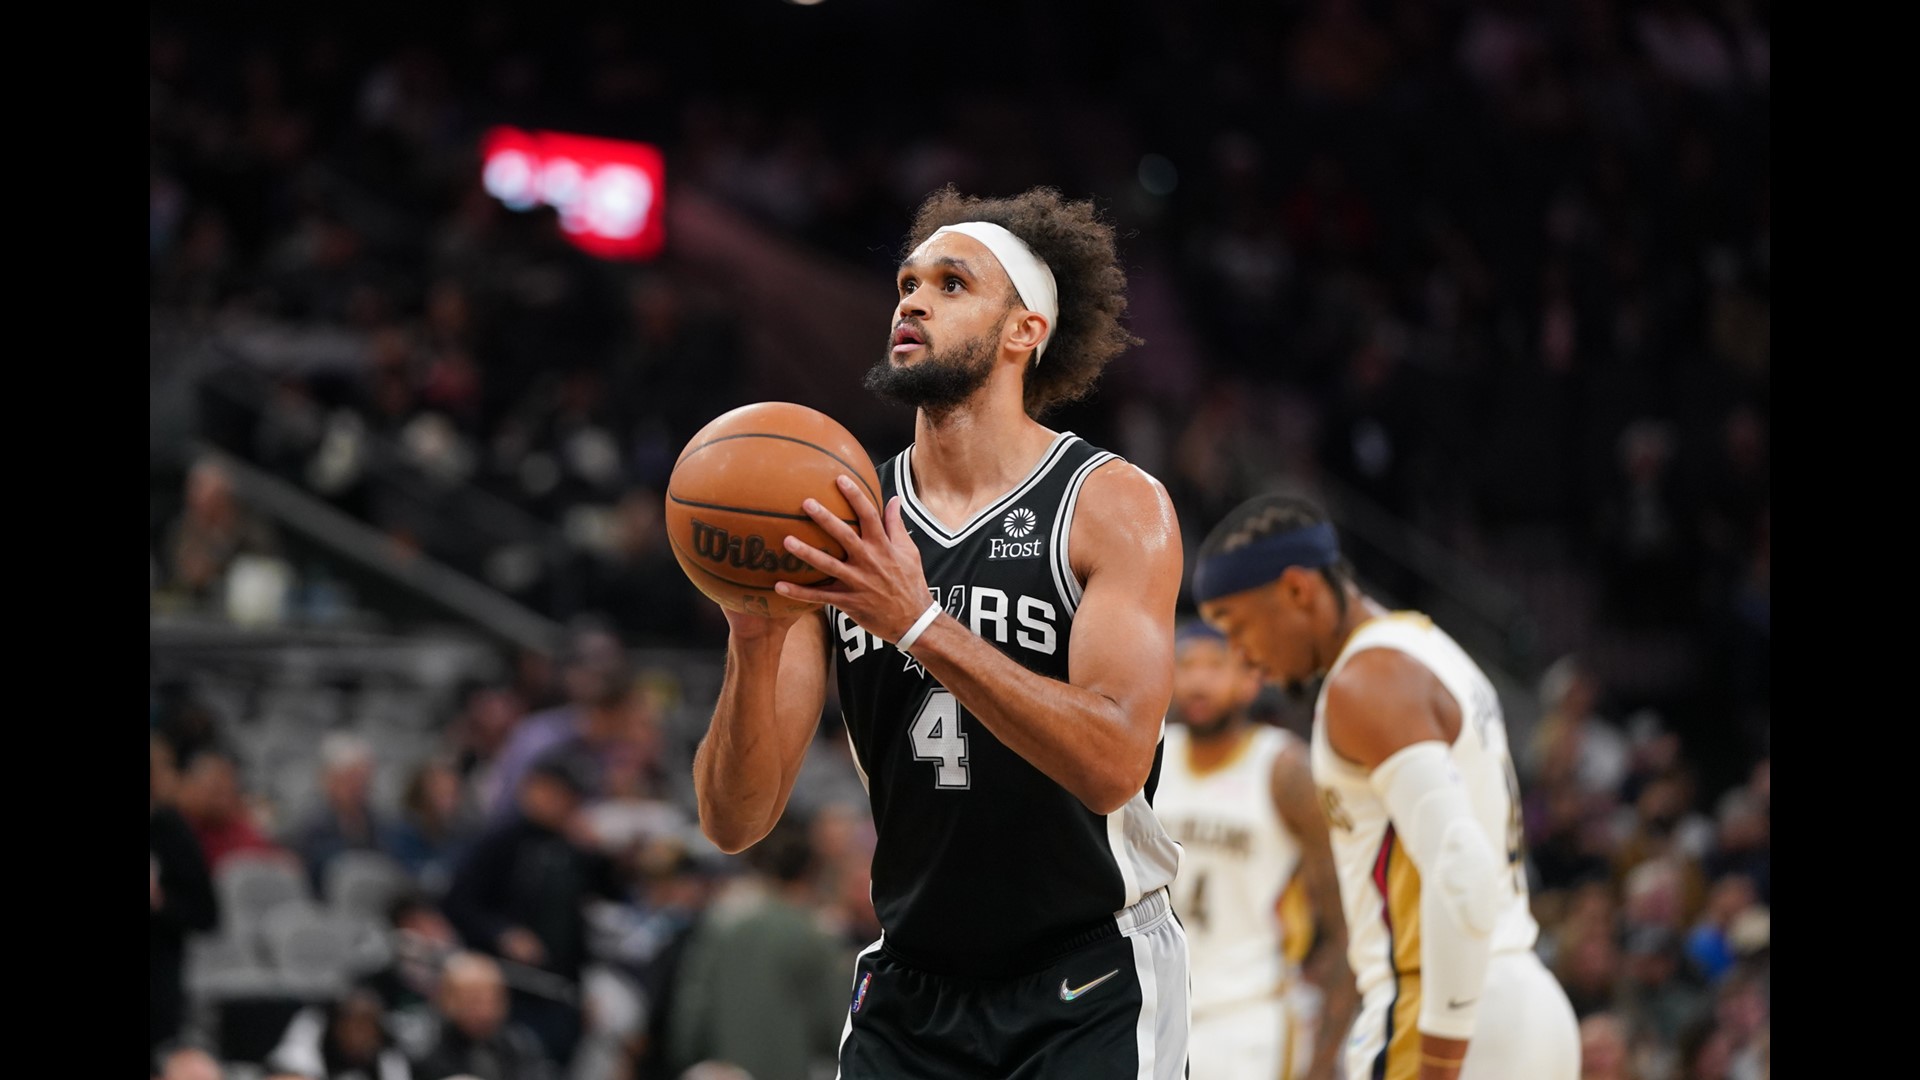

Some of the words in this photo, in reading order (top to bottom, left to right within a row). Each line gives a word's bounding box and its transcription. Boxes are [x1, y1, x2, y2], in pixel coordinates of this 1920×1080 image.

[690, 517, 829, 573] Wilso
[988, 538, 1041, 559] Frost
[837, 584, 1057, 664] SRS
[907, 687, 971, 790] 4
